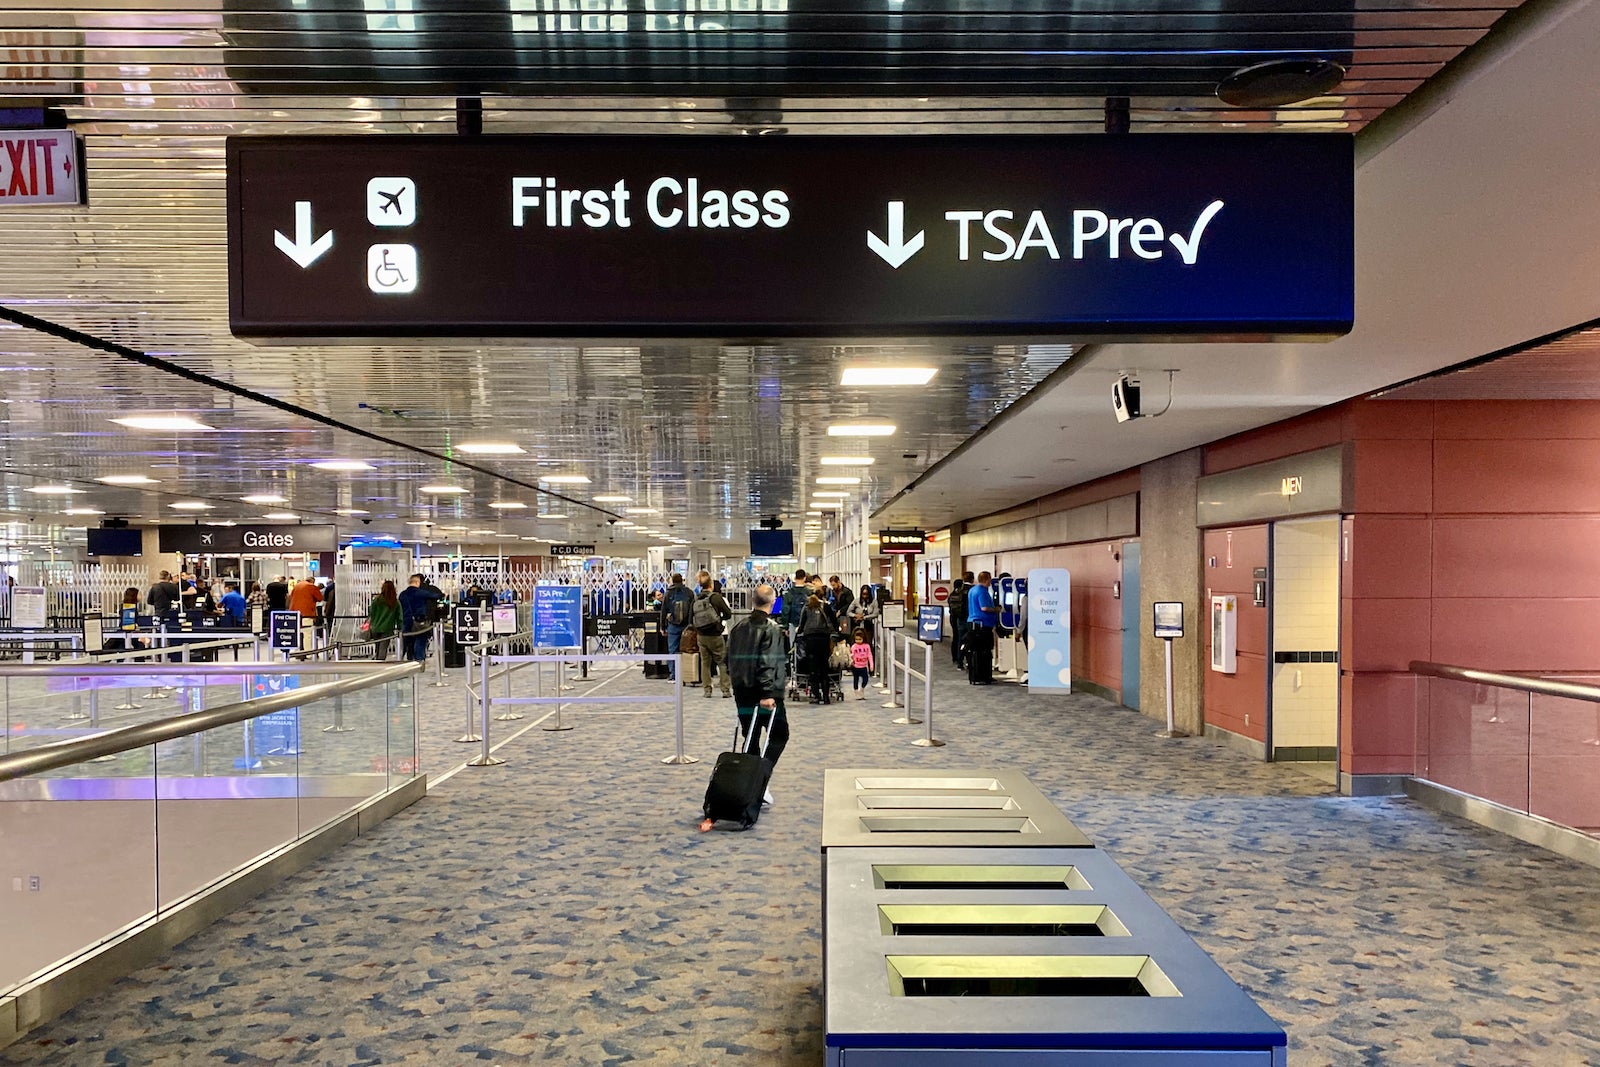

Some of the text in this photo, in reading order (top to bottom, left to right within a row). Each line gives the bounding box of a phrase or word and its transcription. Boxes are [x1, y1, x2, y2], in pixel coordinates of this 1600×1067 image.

[510, 177, 791, 229] First Class
[944, 209, 1165, 261] TSA Pre
[1281, 476, 1302, 495] MEN
[243, 531, 294, 547] Gates
